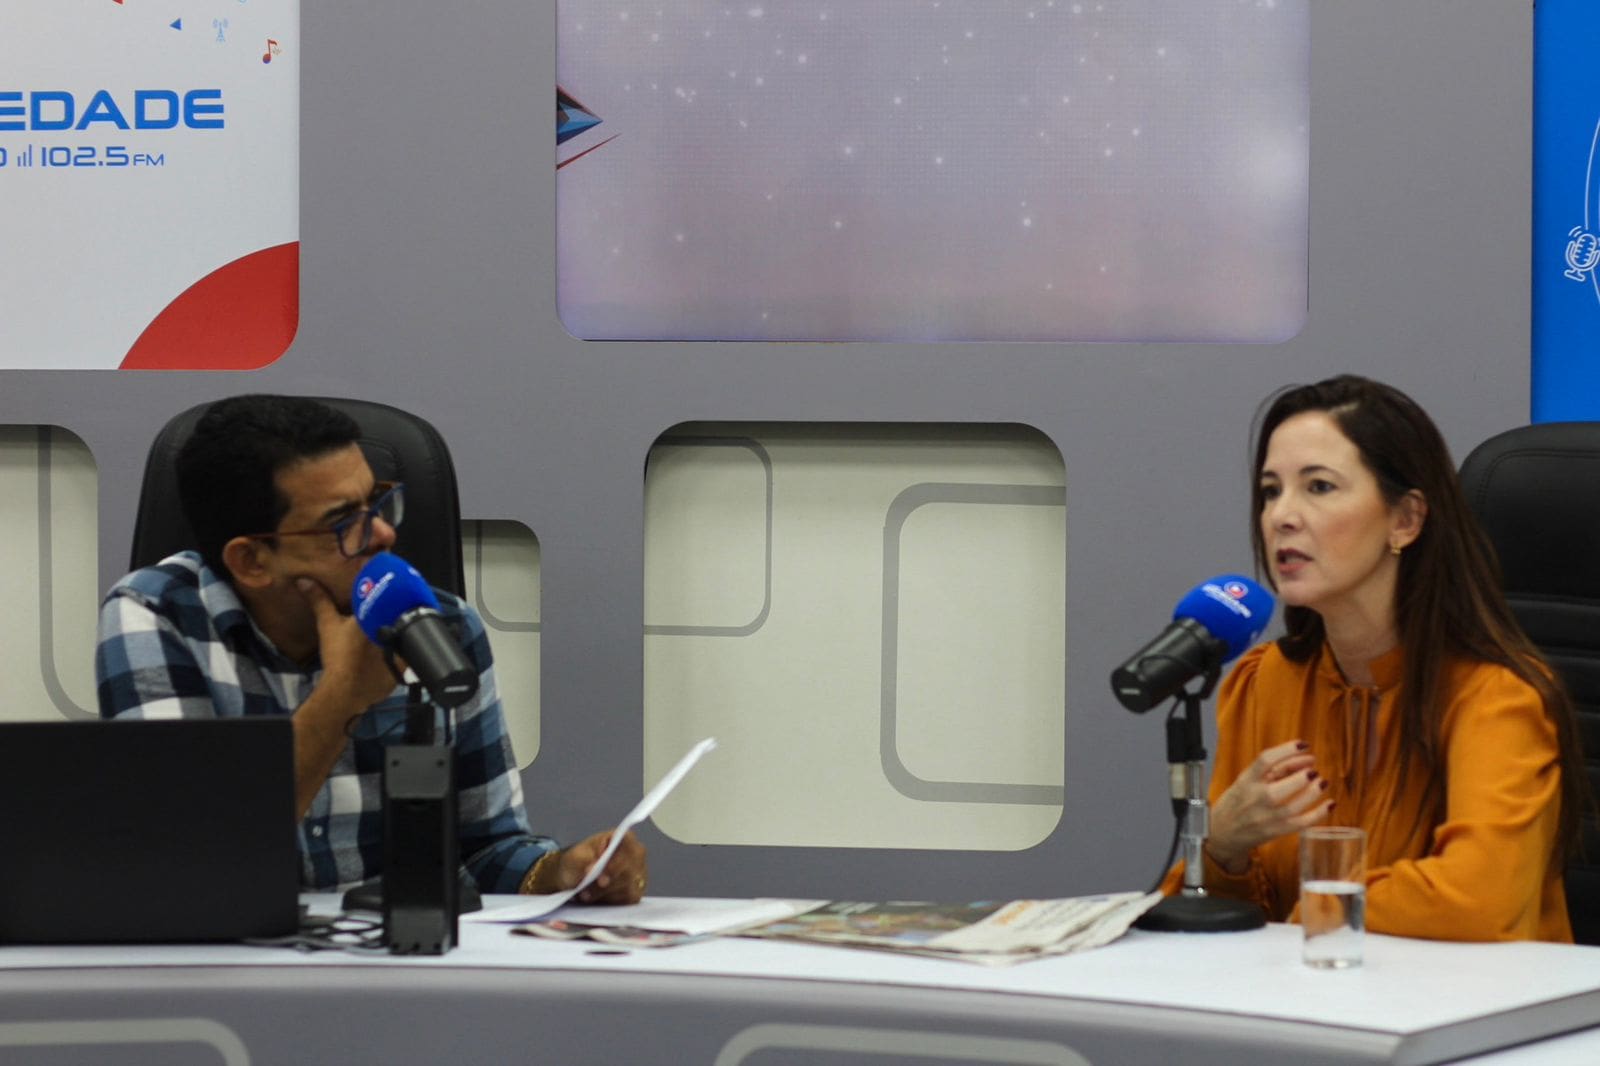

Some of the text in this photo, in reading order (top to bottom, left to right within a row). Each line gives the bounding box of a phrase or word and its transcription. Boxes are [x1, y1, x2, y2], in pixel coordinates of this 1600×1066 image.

[0, 89, 224, 131] EDADE
[41, 146, 164, 167] 102.5 FM
